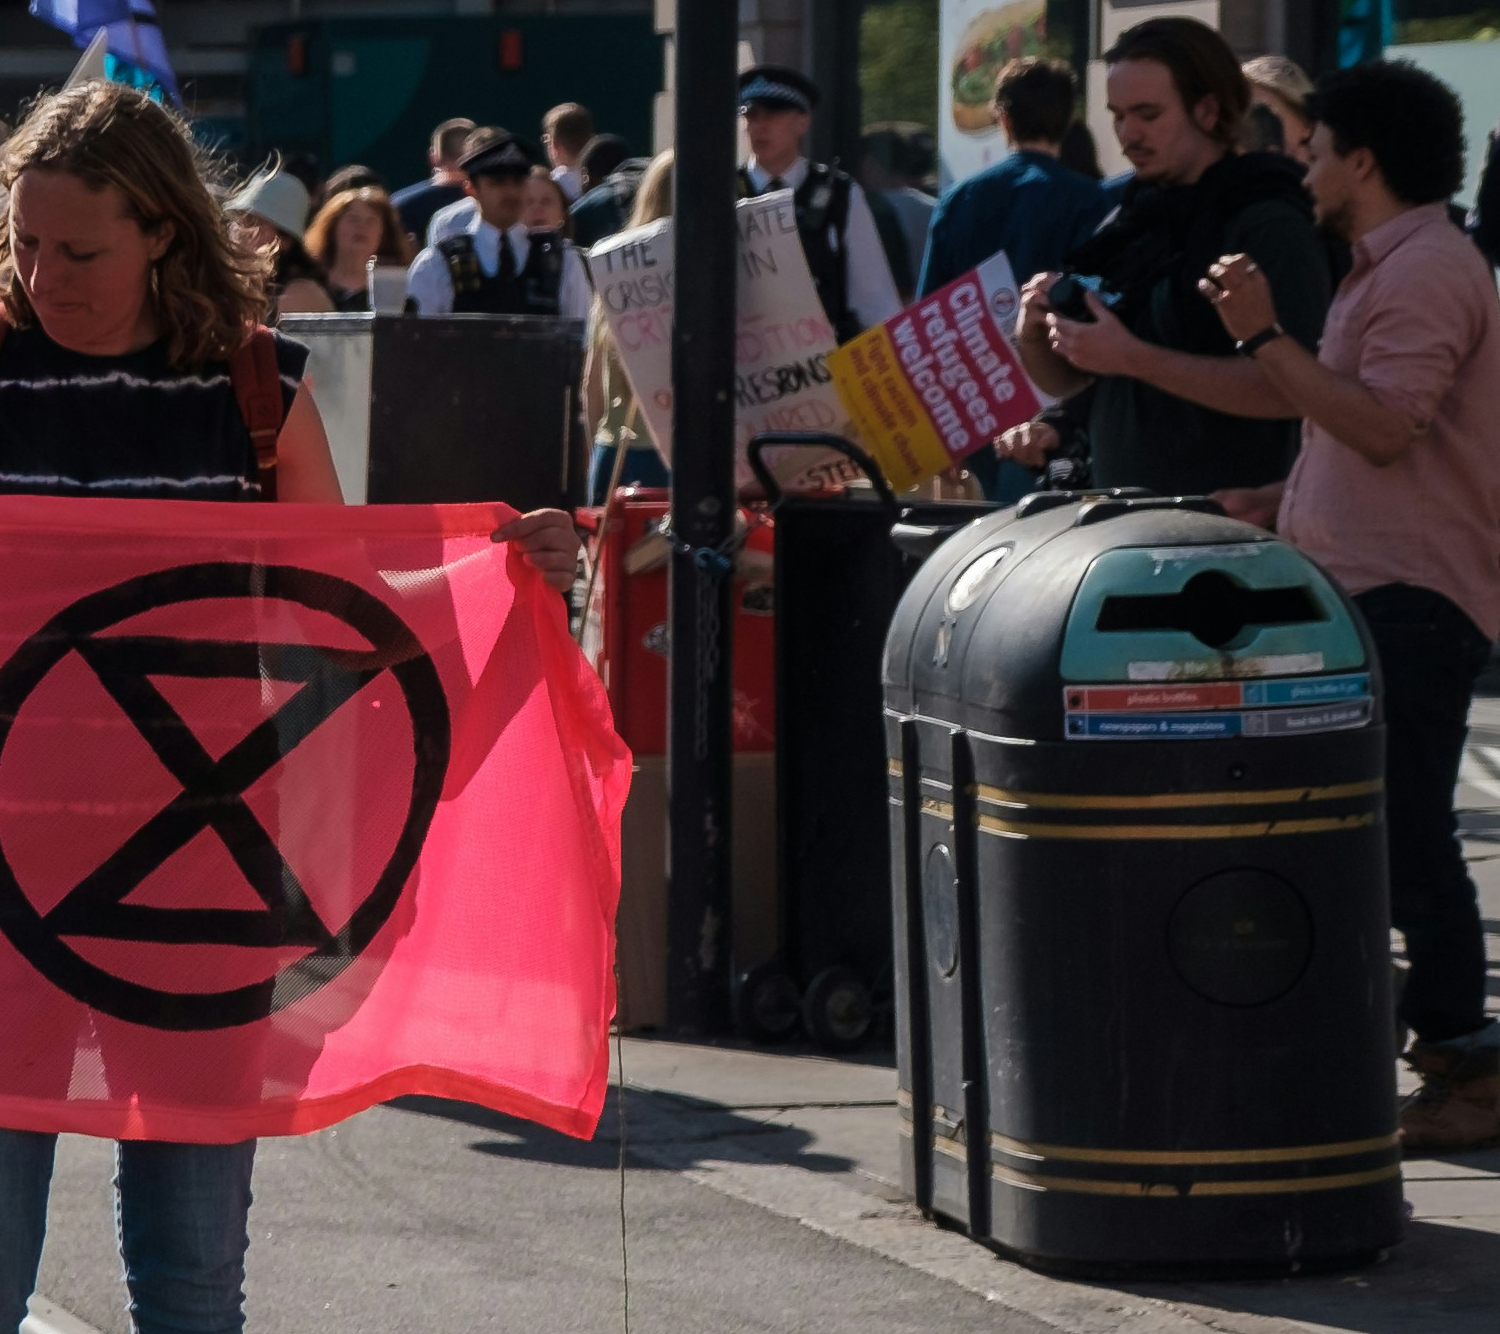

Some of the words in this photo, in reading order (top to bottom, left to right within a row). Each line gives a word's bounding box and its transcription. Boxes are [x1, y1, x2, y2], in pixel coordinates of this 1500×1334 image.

[893, 317, 970, 450] welcome
[920, 300, 998, 436] refugees
[949, 281, 1016, 403] Climate
